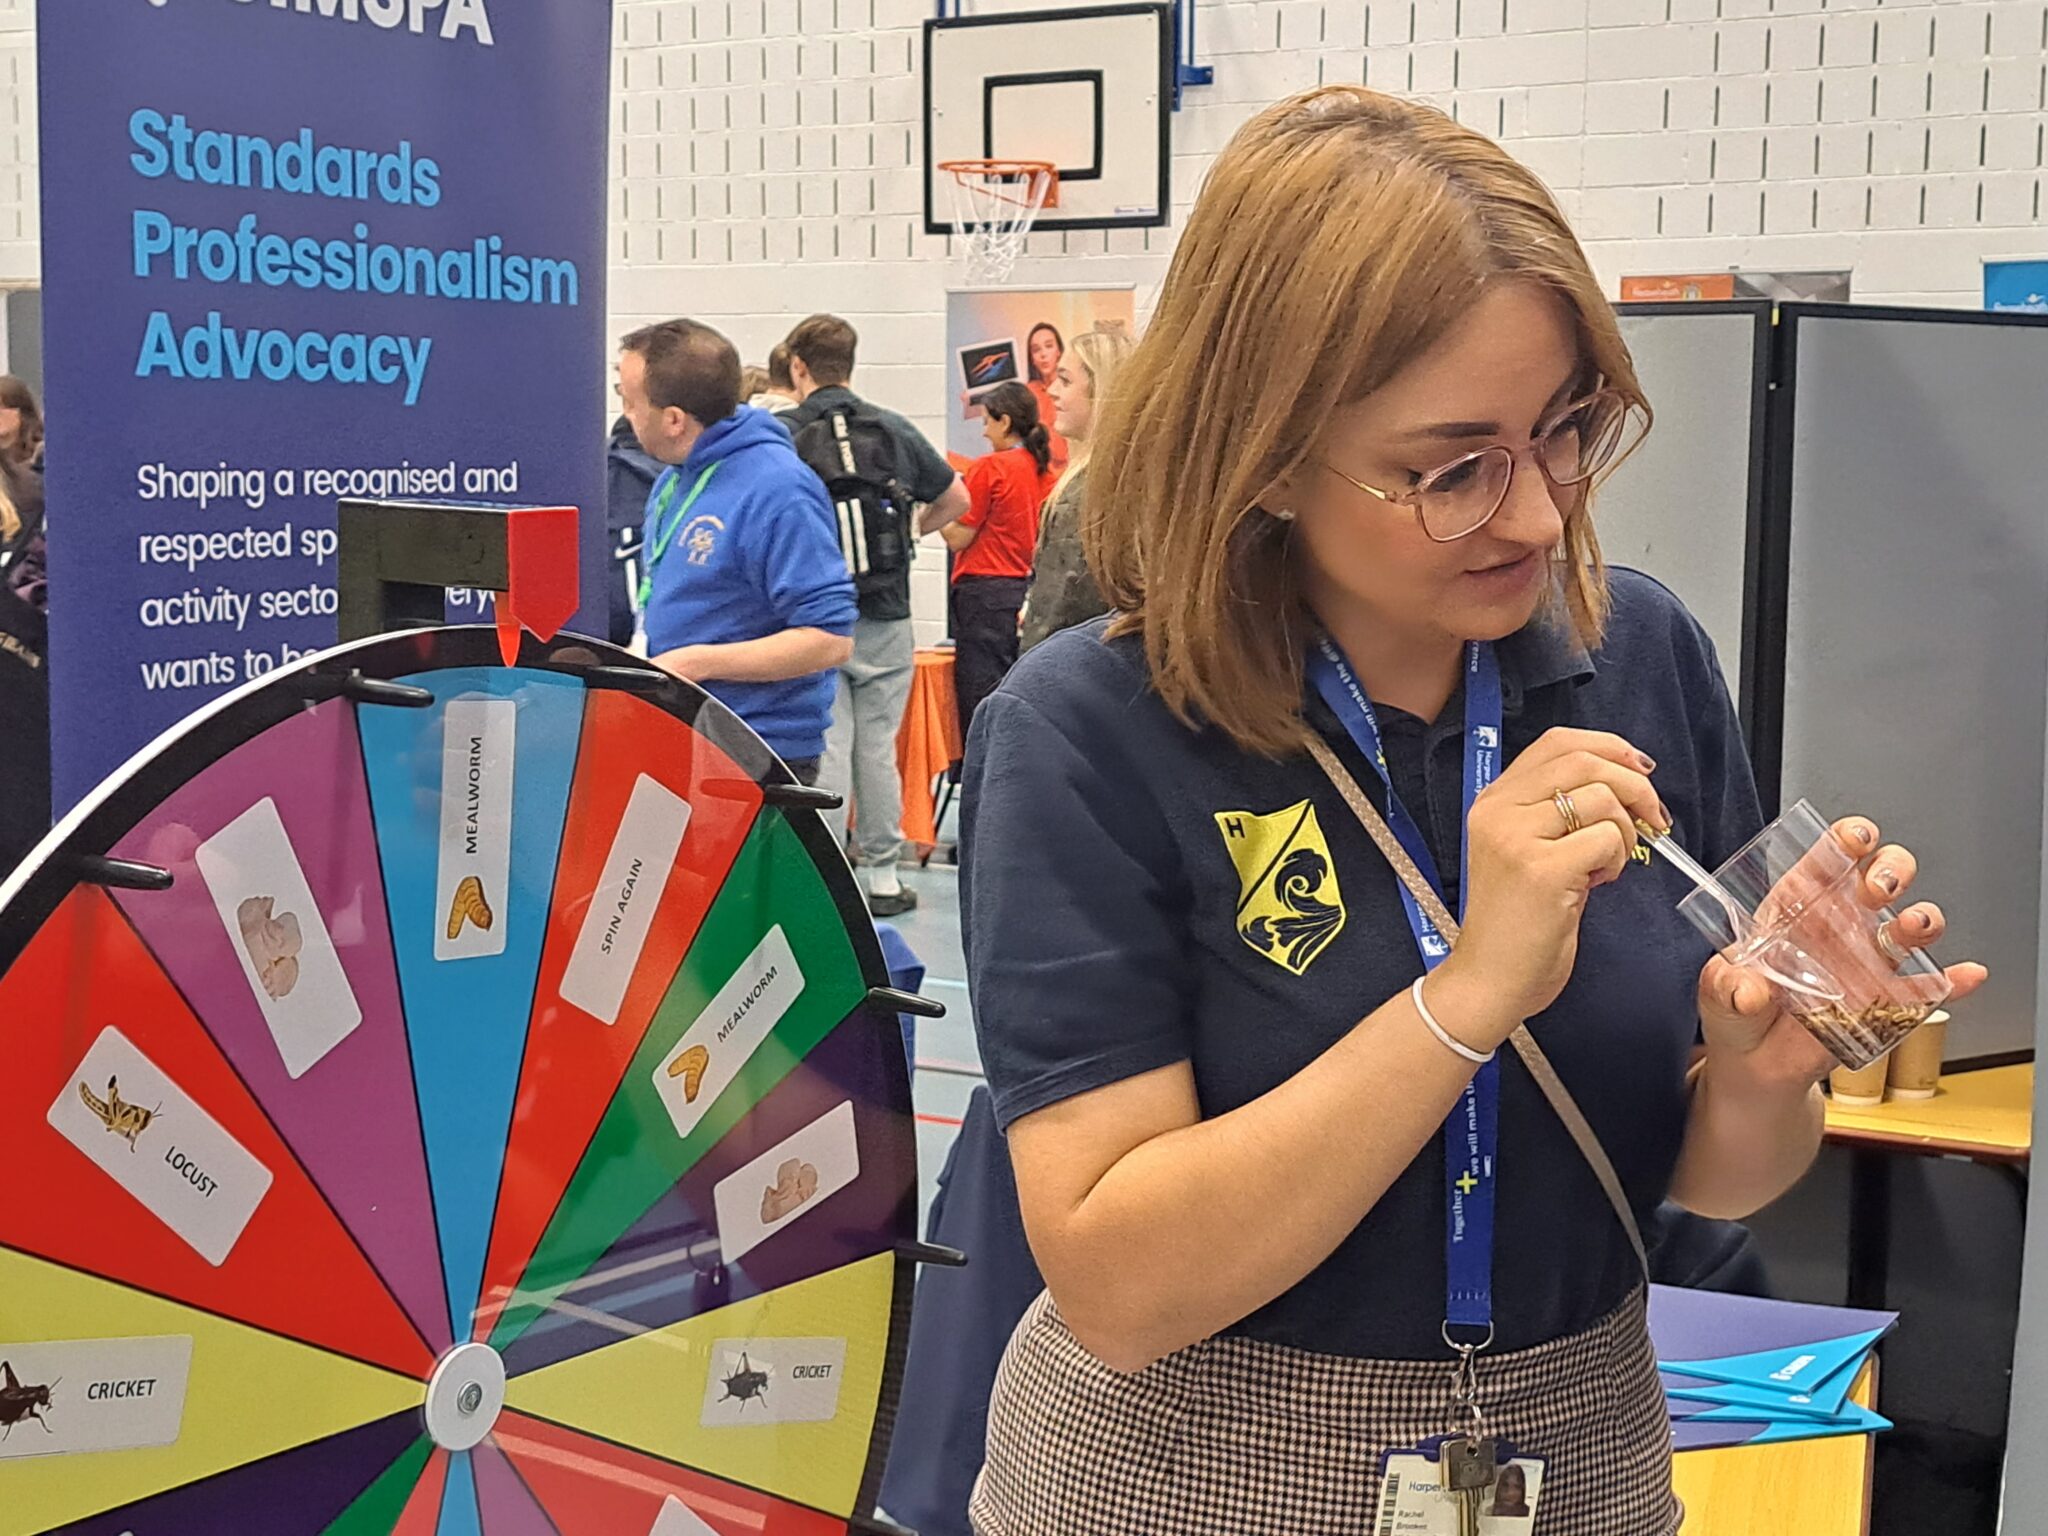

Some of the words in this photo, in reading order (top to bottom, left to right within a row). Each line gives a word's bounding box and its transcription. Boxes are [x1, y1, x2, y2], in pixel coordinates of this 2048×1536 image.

[129, 108, 441, 207] Standards
[133, 210, 579, 305] Professionalism
[136, 311, 432, 406] Advocacy
[138, 463, 265, 510] Shaping
[273, 469, 295, 496] a
[303, 460, 456, 499] recognised
[463, 461, 518, 494] and
[139, 523, 292, 572] respected
[301, 527, 338, 566] sp
[140, 585, 255, 628] activity
[259, 587, 338, 618] secto
[140, 650, 235, 691] wants
[240, 649, 274, 679] to
[465, 736, 483, 854] MEALWORM
[1224, 817, 1246, 839] H
[601, 915, 622, 955] SPIN
[619, 858, 643, 914] AGAIN
[716, 973, 778, 1043] MEALWORM
[1466, 1096, 1478, 1131] make
[1467, 1132, 1478, 1156] will
[1472, 1157, 1480, 1176] we
[164, 1145, 218, 1198] LOCUST
[1452, 1189, 1466, 1243] Together
[87, 1378, 157, 1400] CRICKET
[792, 1364, 832, 1380] CRICKET
